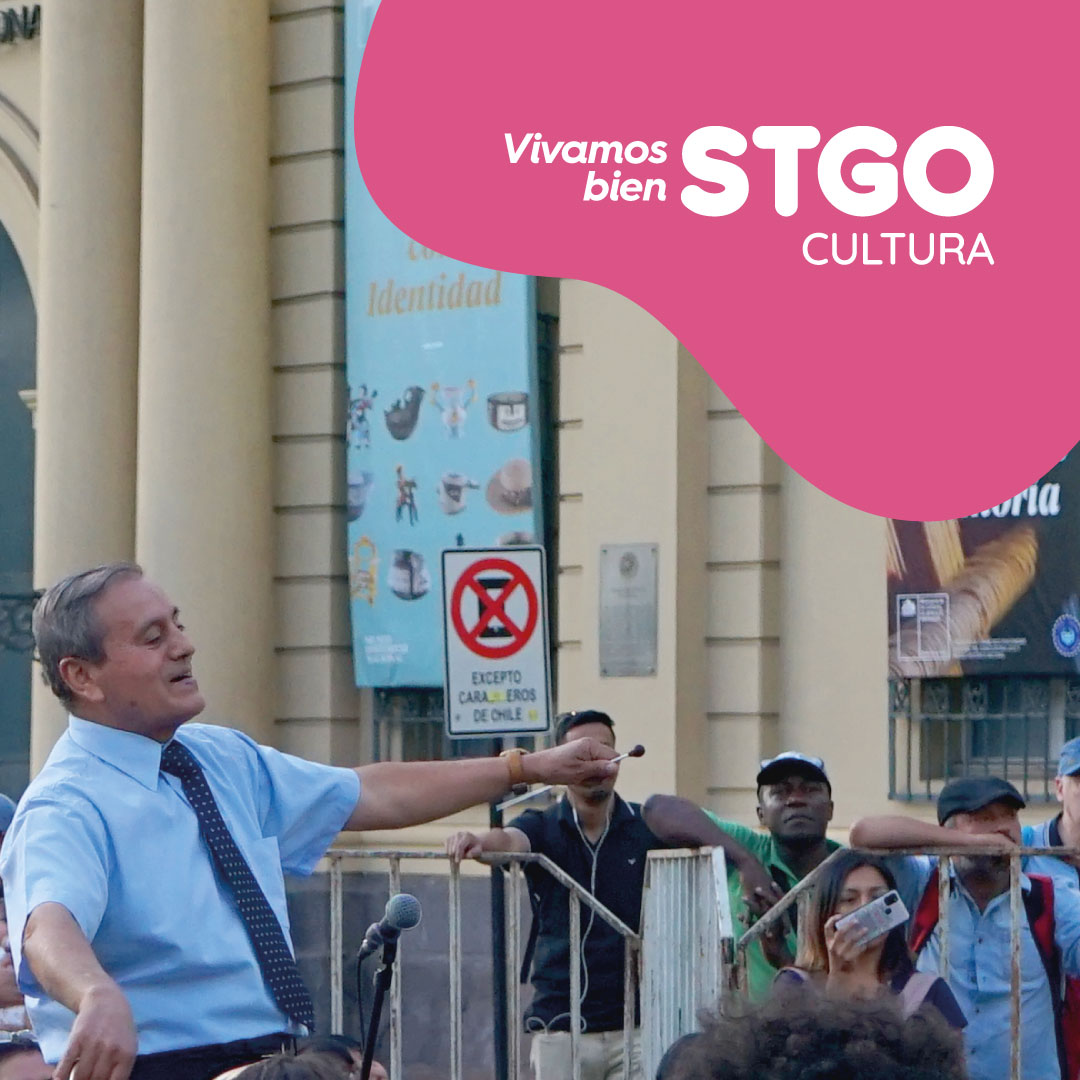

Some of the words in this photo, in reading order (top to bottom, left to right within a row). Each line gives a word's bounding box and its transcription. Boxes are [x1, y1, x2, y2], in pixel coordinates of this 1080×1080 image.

[367, 270, 503, 317] Identidad
[472, 670, 522, 685] EXCEPTO
[458, 687, 537, 704] CARAEROS
[473, 708, 489, 722] DE
[491, 706, 522, 721] CHILE
